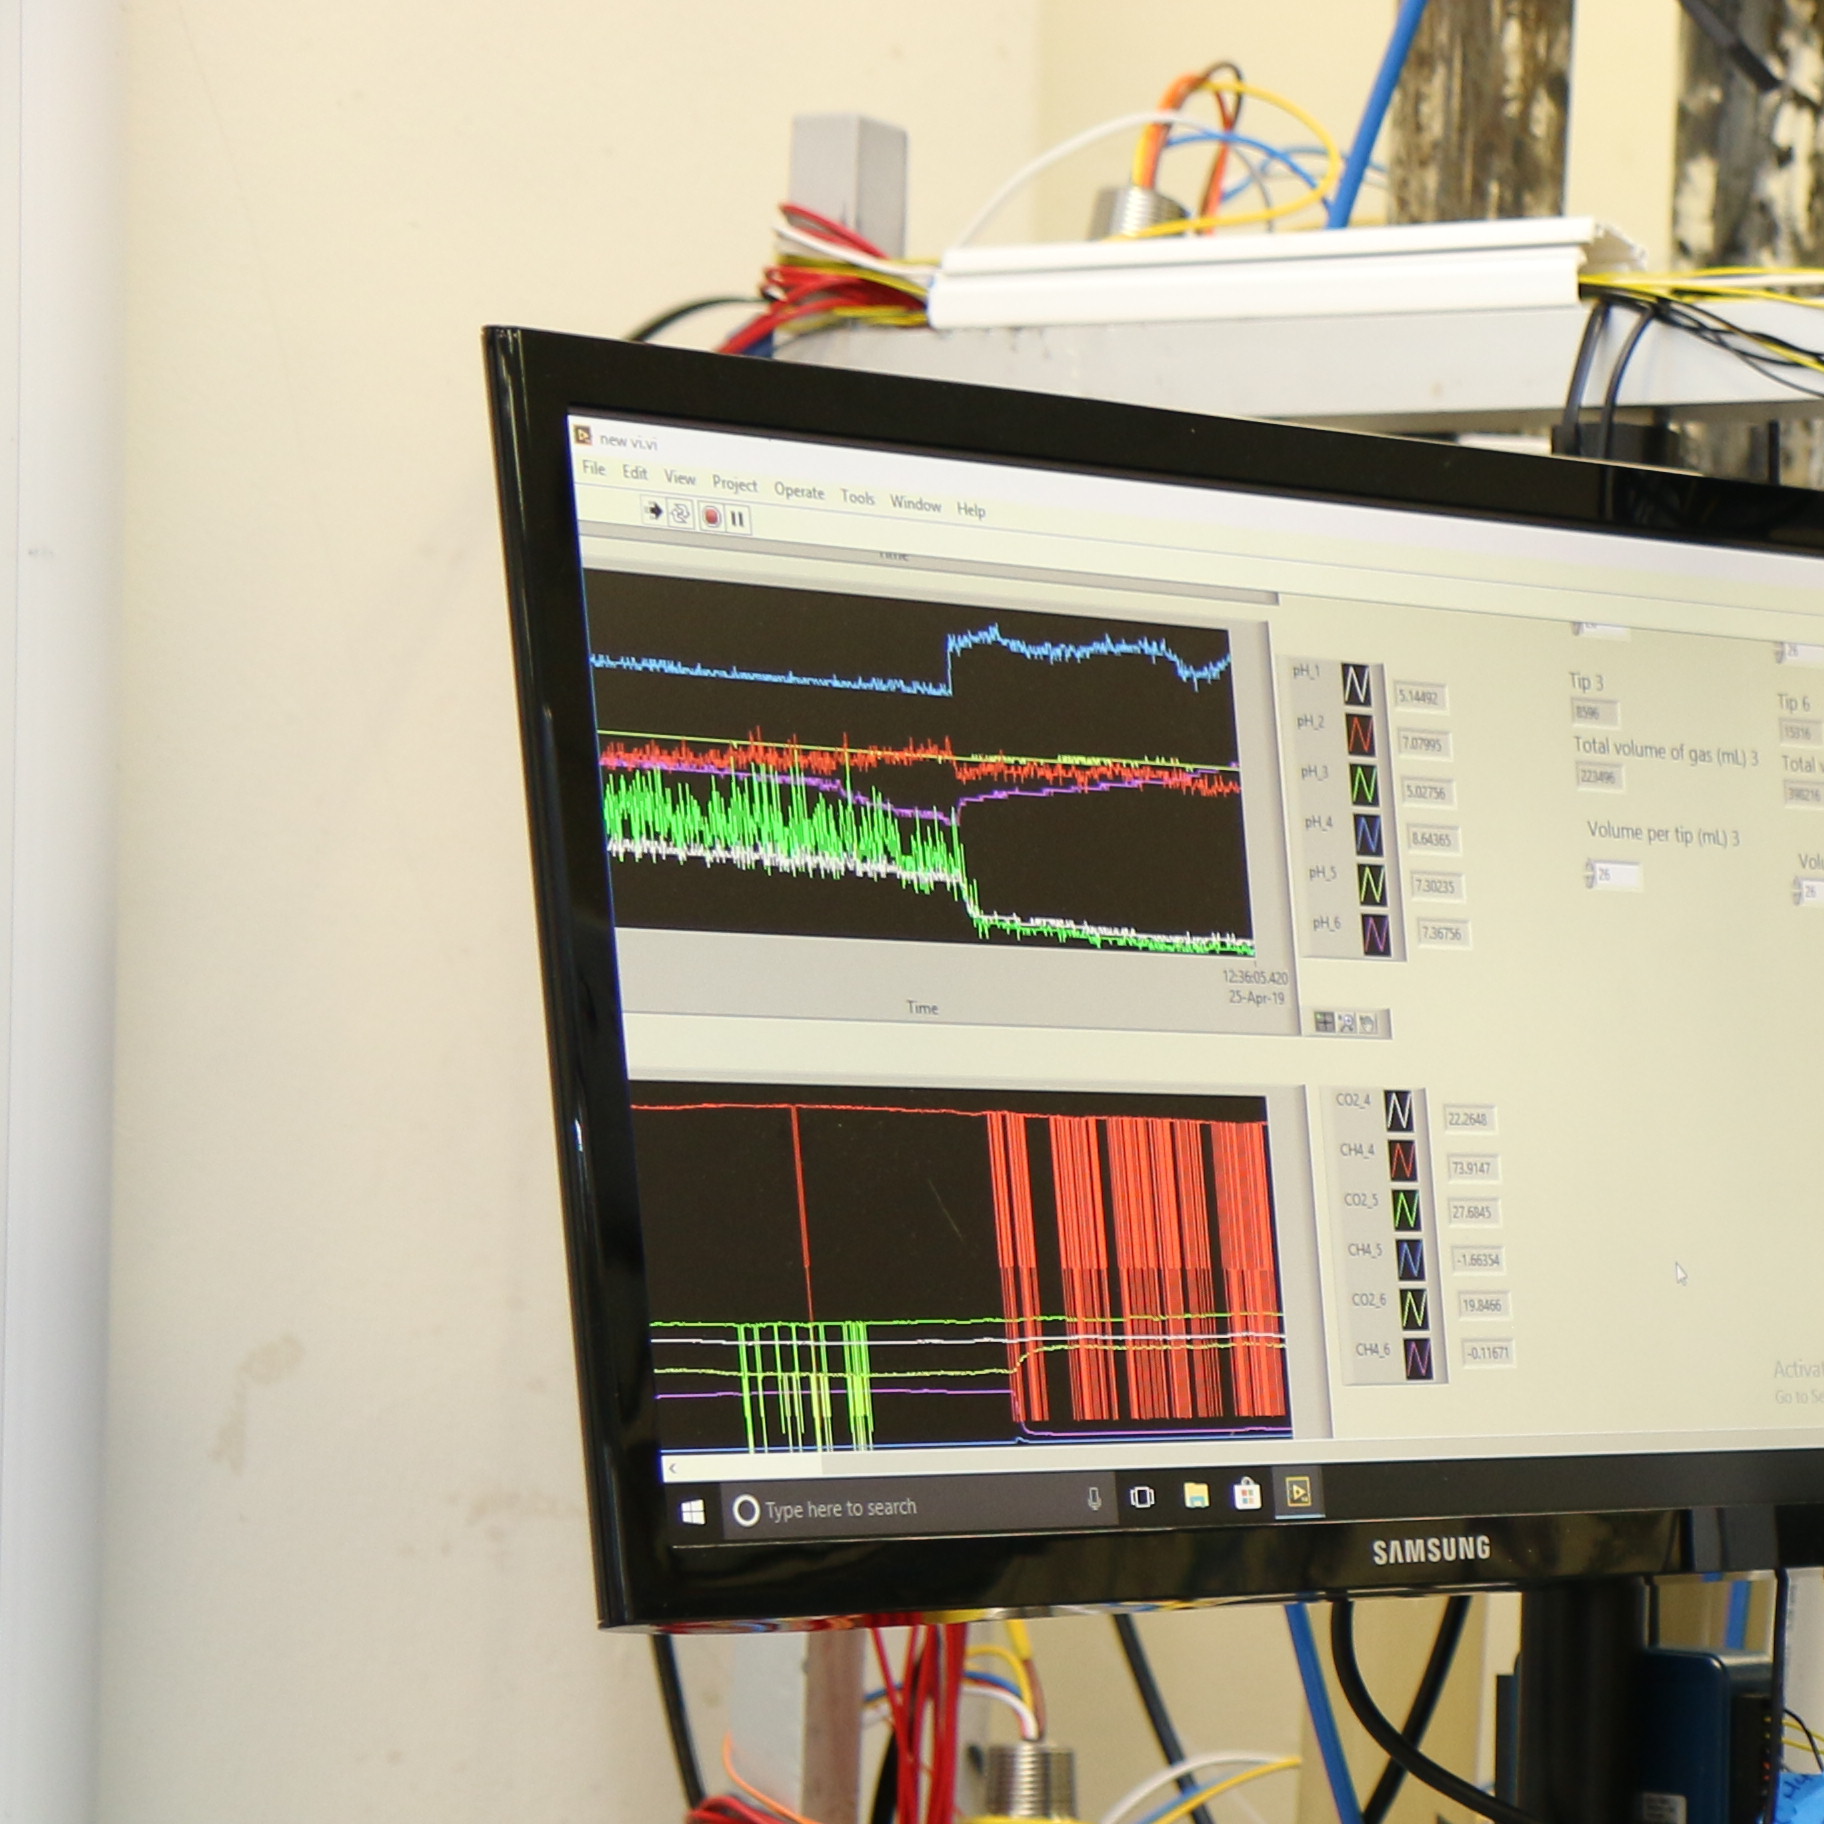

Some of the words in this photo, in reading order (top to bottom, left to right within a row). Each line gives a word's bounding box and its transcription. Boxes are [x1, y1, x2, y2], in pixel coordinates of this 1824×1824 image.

[600, 435, 627, 448] new
[630, 434, 658, 451] vi.vi
[582, 458, 605, 475] File
[623, 463, 648, 480] Edit
[664, 468, 696, 485] View
[712, 474, 758, 494] Project
[774, 481, 825, 500] Operate
[840, 488, 875, 505] Tools
[890, 494, 941, 512] Window
[957, 502, 986, 520] Help
[1293, 664, 1320, 680] pH_1
[1569, 671, 1591, 693] Tip
[1595, 674, 1604, 691] 3
[1399, 690, 1438, 706] 5.14492
[1778, 693, 1798, 714] Tip
[1802, 696, 1811, 712] 6
[1297, 715, 1324, 731] pH_2
[1402, 736, 1442, 752] 7.07995
[1574, 736, 1610, 755] Total
[1614, 740, 1666, 759] volume
[1671, 744, 1684, 760] of
[1689, 748, 1713, 767] gas
[1717, 748, 1747, 768] (mL)
[1751, 751, 1759, 766] 3
[1782, 755, 1815, 773] Total
[1301, 765, 1328, 781] pH_3
[1406, 784, 1446, 800] 5.02756
[1305, 816, 1333, 832] pH_4
[1587, 820, 1643, 840] Volume
[1648, 828, 1669, 845] per
[1675, 826, 1693, 847] tip
[1698, 828, 1728, 848] (mL)
[1732, 830, 1740, 847] 3
[1309, 866, 1337, 882] pH_5
[1599, 868, 1611, 881] 26
[1416, 879, 1455, 894] 7.30235
[1805, 886, 1816, 898] 26
[1313, 916, 1341, 933] pH_6
[1223, 969, 1288, 985] 12:36:05.420
[1229, 990, 1285, 1007] 25-Apr-19
[907, 1000, 939, 1015] Time
[1336, 1093, 1371, 1109] CO2_4
[1449, 1113, 1487, 1126] 22.2648
[1340, 1143, 1375, 1159] CH4_4
[1453, 1162, 1491, 1175] 73.9147
[1344, 1193, 1379, 1209] CO2_5
[1453, 1206, 1492, 1219] 27.6845
[1348, 1243, 1382, 1259] CH4_5
[1352, 1293, 1387, 1309] CO2_6
[1356, 1343, 1391, 1359] CH4_6
[1775, 1390, 1792, 1405] Go
[1796, 1391, 1808, 1404] to
[765, 1501, 803, 1523] Type
[807, 1501, 842, 1518] here
[846, 1500, 863, 1516] to
[867, 1498, 917, 1516] search
[1373, 1535, 1491, 1565] SAMSUNG
